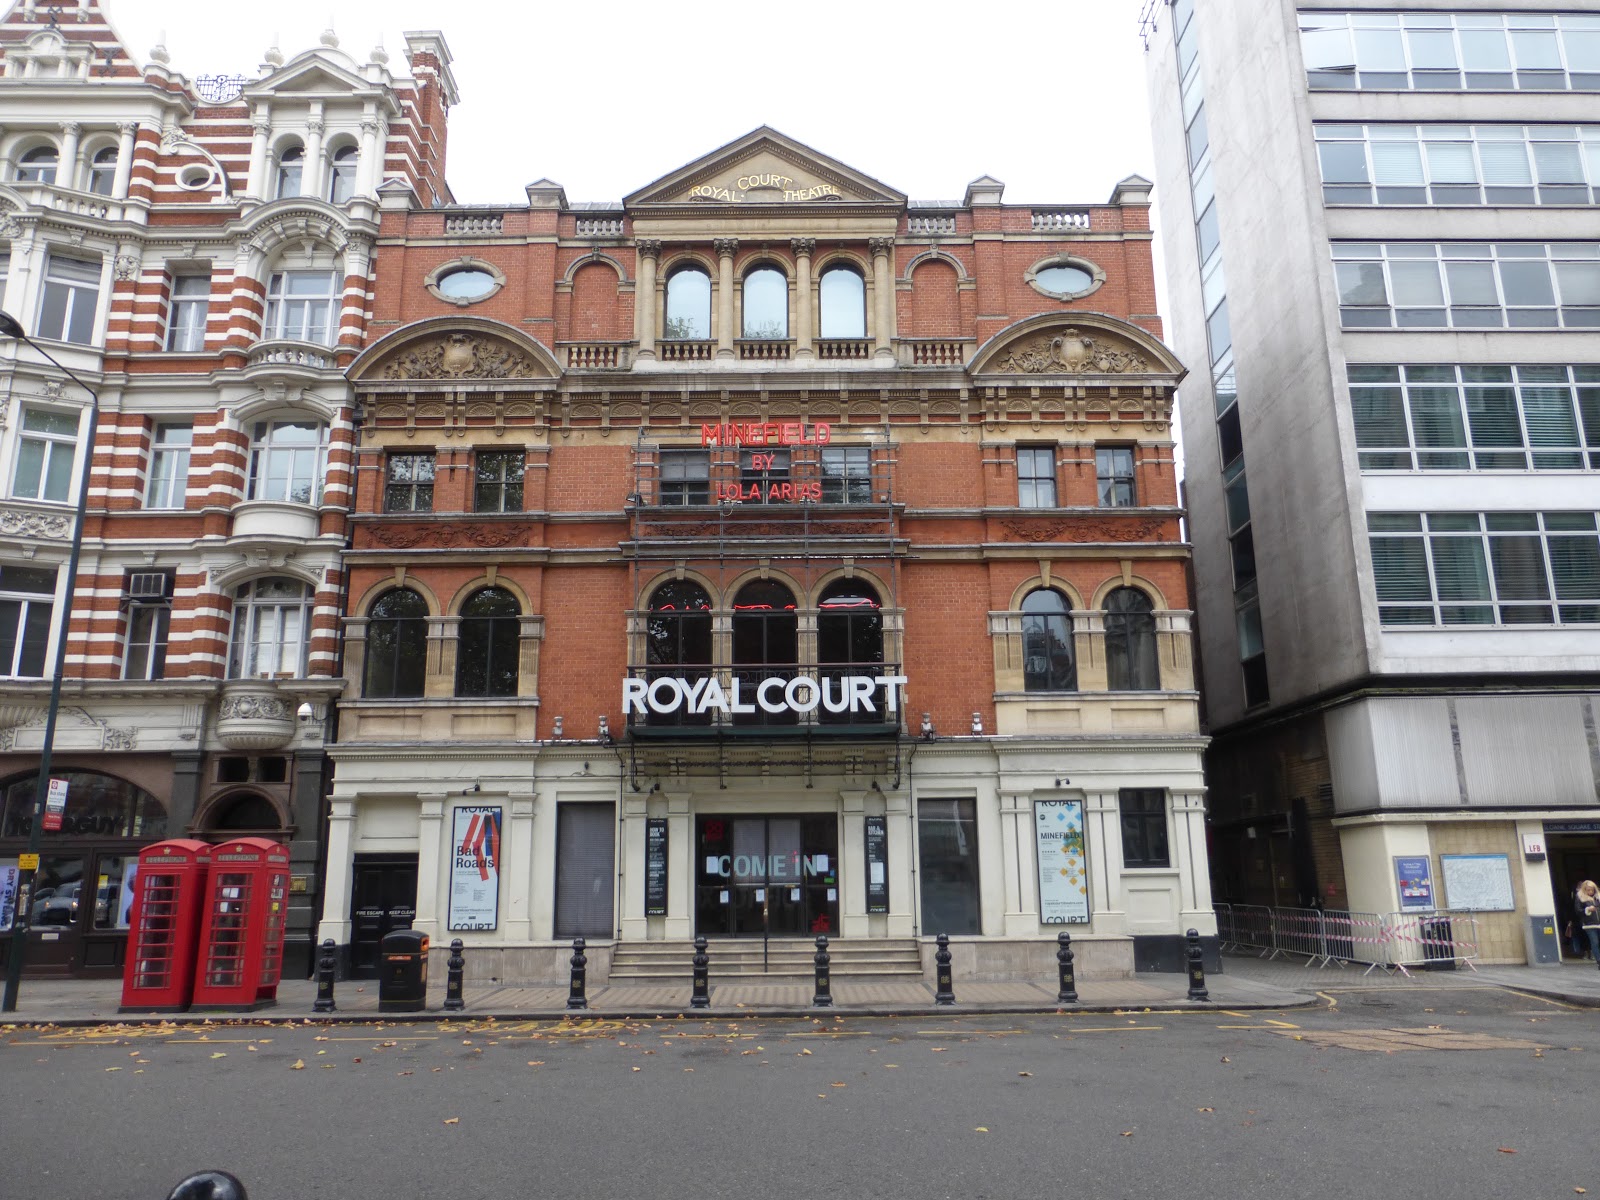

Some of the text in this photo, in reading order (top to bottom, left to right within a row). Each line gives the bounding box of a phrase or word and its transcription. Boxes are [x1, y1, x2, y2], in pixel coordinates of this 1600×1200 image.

[691, 173, 840, 202] ROYAL COURT THEATRE
[701, 422, 830, 446] MINEFIELD
[752, 454, 776, 471] BY
[717, 483, 823, 499] LOLA ARIAS
[622, 676, 908, 714] ROYAL COURT
[457, 846, 480, 856] Bad
[1528, 844, 1541, 852] LFB
[456, 857, 494, 868] Roads
[718, 855, 787, 877] COME
[6, 868, 15, 886] DRY
